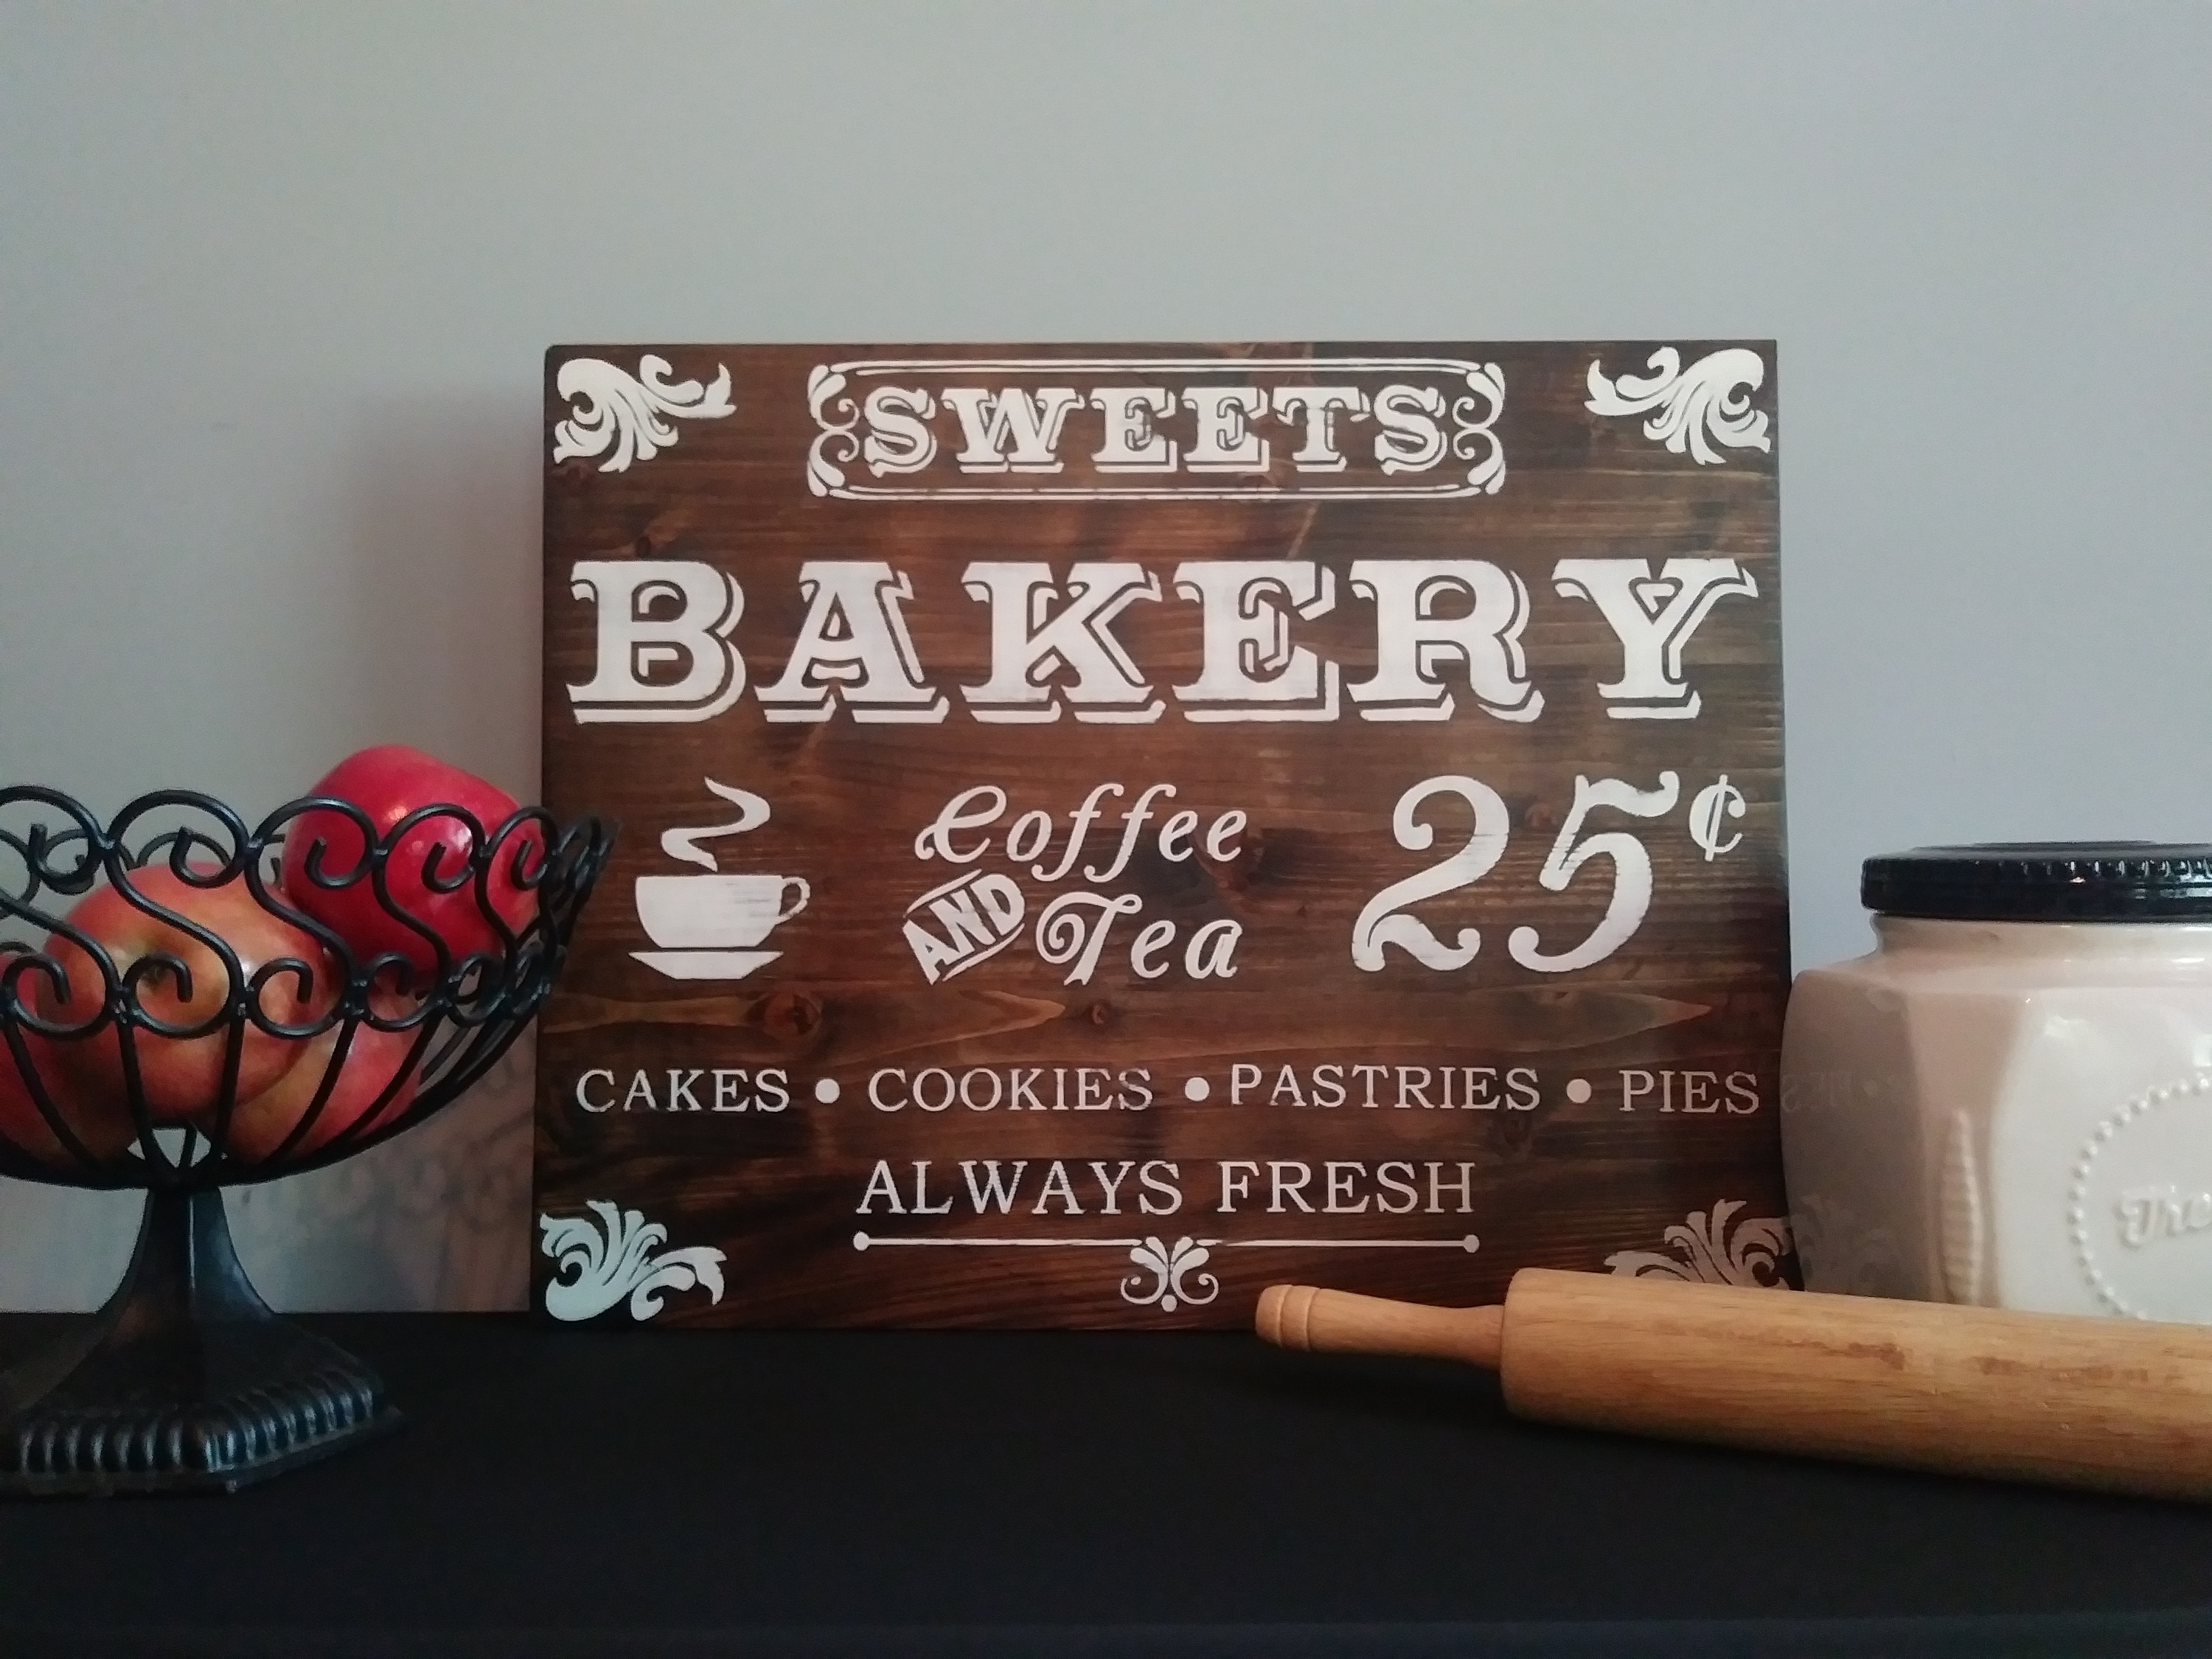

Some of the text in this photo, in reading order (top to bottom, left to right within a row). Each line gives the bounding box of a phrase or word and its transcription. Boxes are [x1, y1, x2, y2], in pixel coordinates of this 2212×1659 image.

[863, 384, 1448, 479] SWEETS
[566, 557, 1759, 724] BAKERY
[914, 782, 1247, 886] Coffee
[902, 872, 1242, 986] AND Tea
[576, 1068, 790, 1113] CAKES
[868, 1068, 1153, 1112] COOKIES
[1231, 1063, 1540, 1110] PASTRIES
[1618, 1069, 1759, 1114] PIES
[855, 1159, 1475, 1215] ALWAYS FRESH
